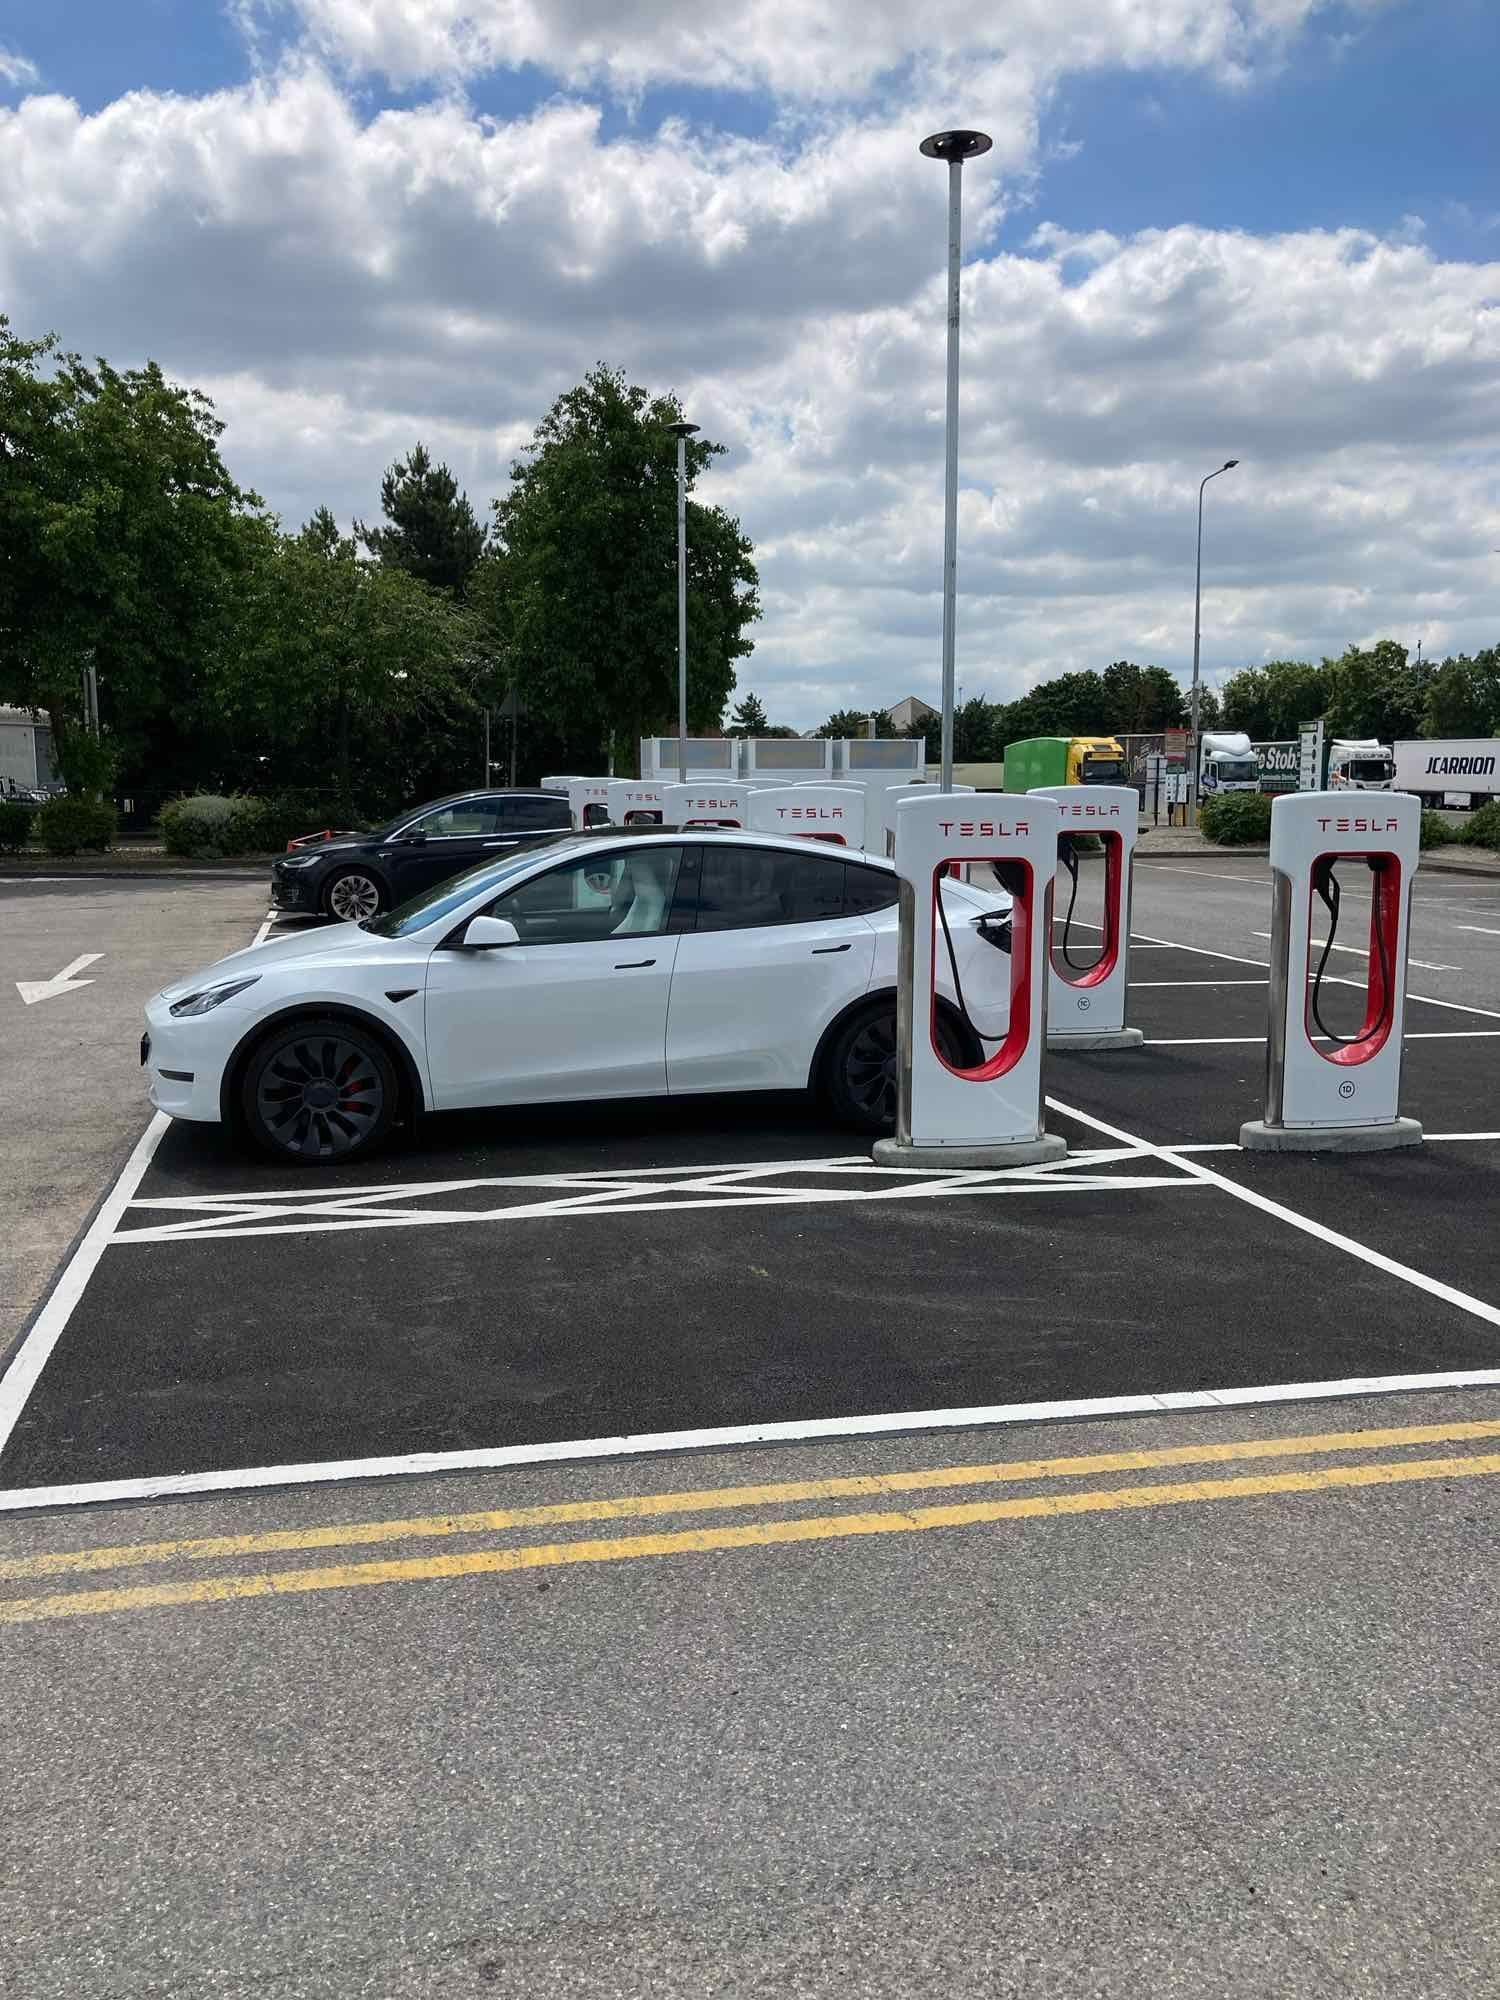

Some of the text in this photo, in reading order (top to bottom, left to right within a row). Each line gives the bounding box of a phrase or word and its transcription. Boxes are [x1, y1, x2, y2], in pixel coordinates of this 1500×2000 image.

[1425, 757, 1495, 775] JCARRION
[685, 800, 738, 808] TESLA
[776, 808, 842, 818] TESLA
[1058, 805, 1120, 816] TESLA
[938, 823, 1029, 837] TESLA
[1316, 818, 1397, 832] TESLA
